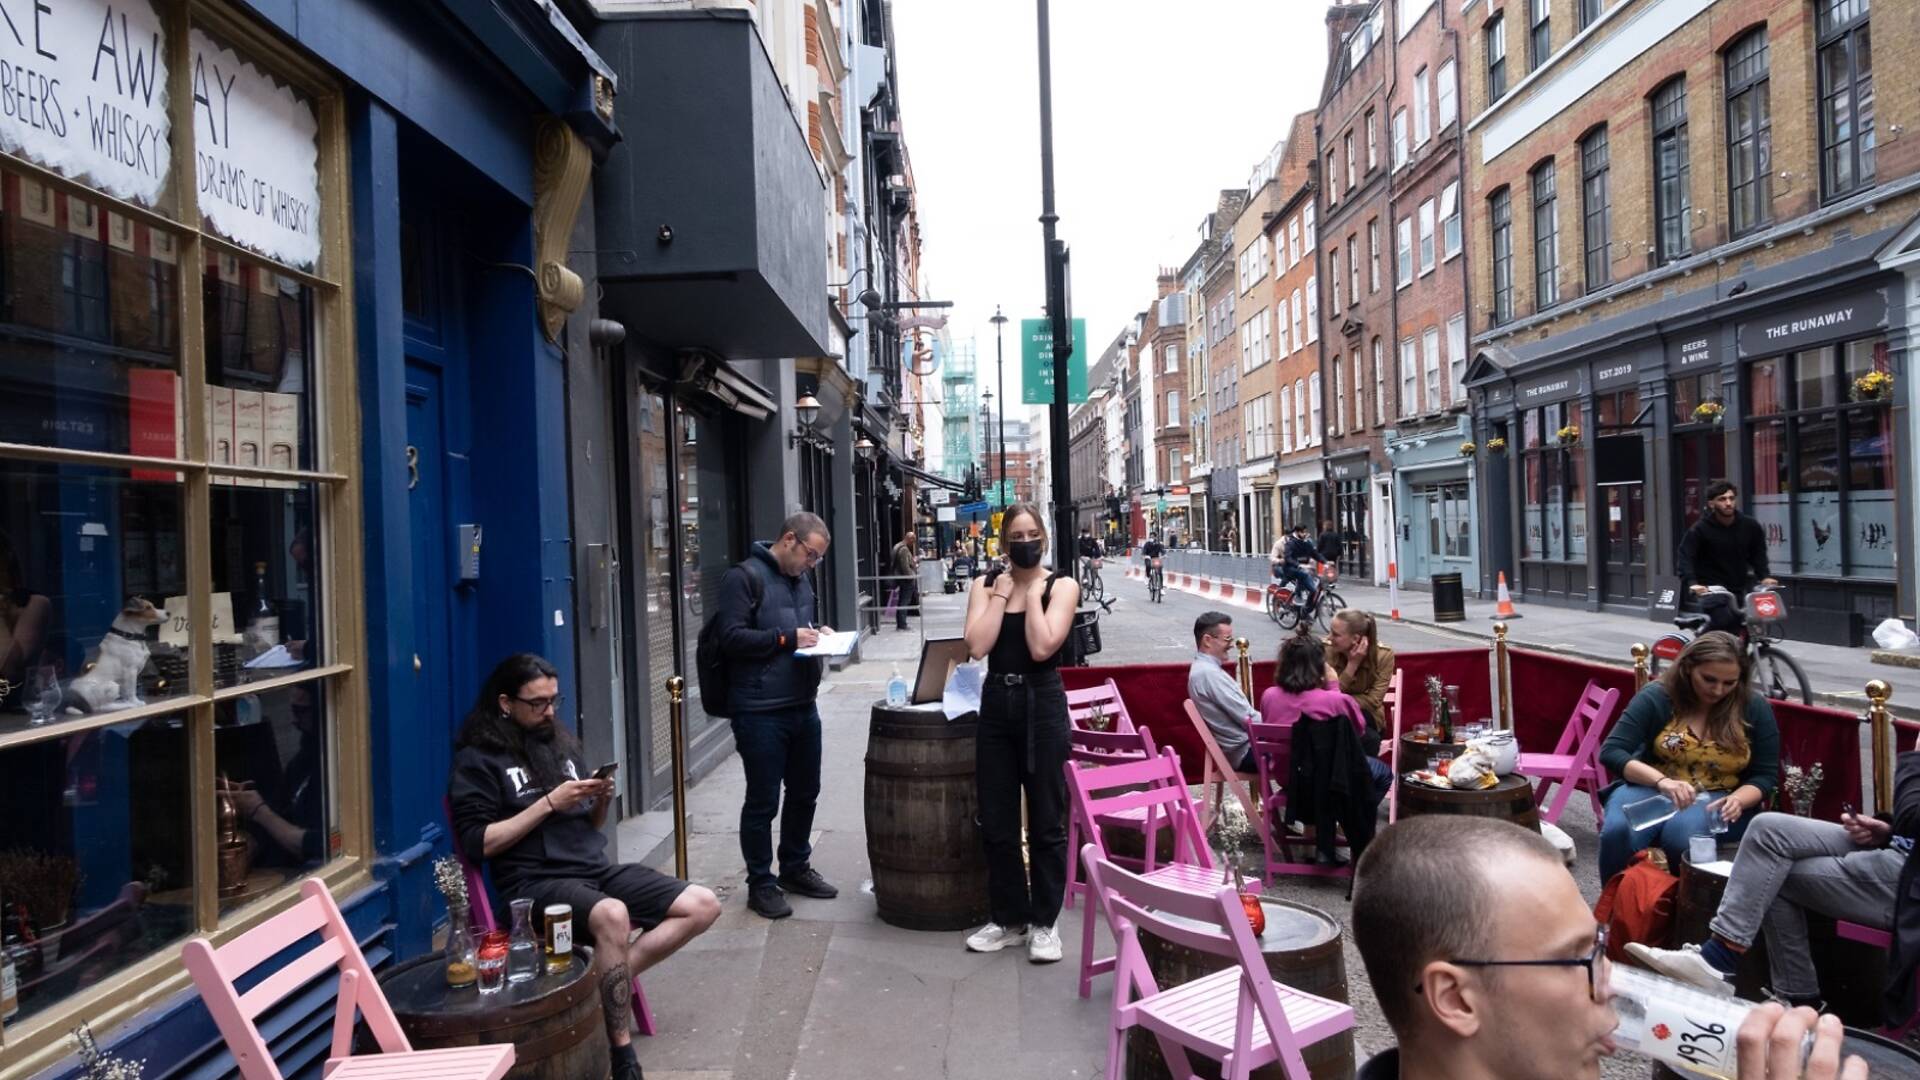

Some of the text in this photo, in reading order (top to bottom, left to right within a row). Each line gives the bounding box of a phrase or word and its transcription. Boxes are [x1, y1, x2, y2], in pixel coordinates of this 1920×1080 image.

[1, 59, 67, 138] BEERS
[87, 95, 160, 179] WHISKY
[198, 150, 309, 235] DRAMS OF WHISKY
[1766, 308, 1853, 339] THE RUNAWAY
[1682, 339, 1708, 352] BEERS
[1688, 350, 1709, 363] WINE
[1526, 388, 1538, 398] THE
[1676, 1011, 1726, 1069] 1936
